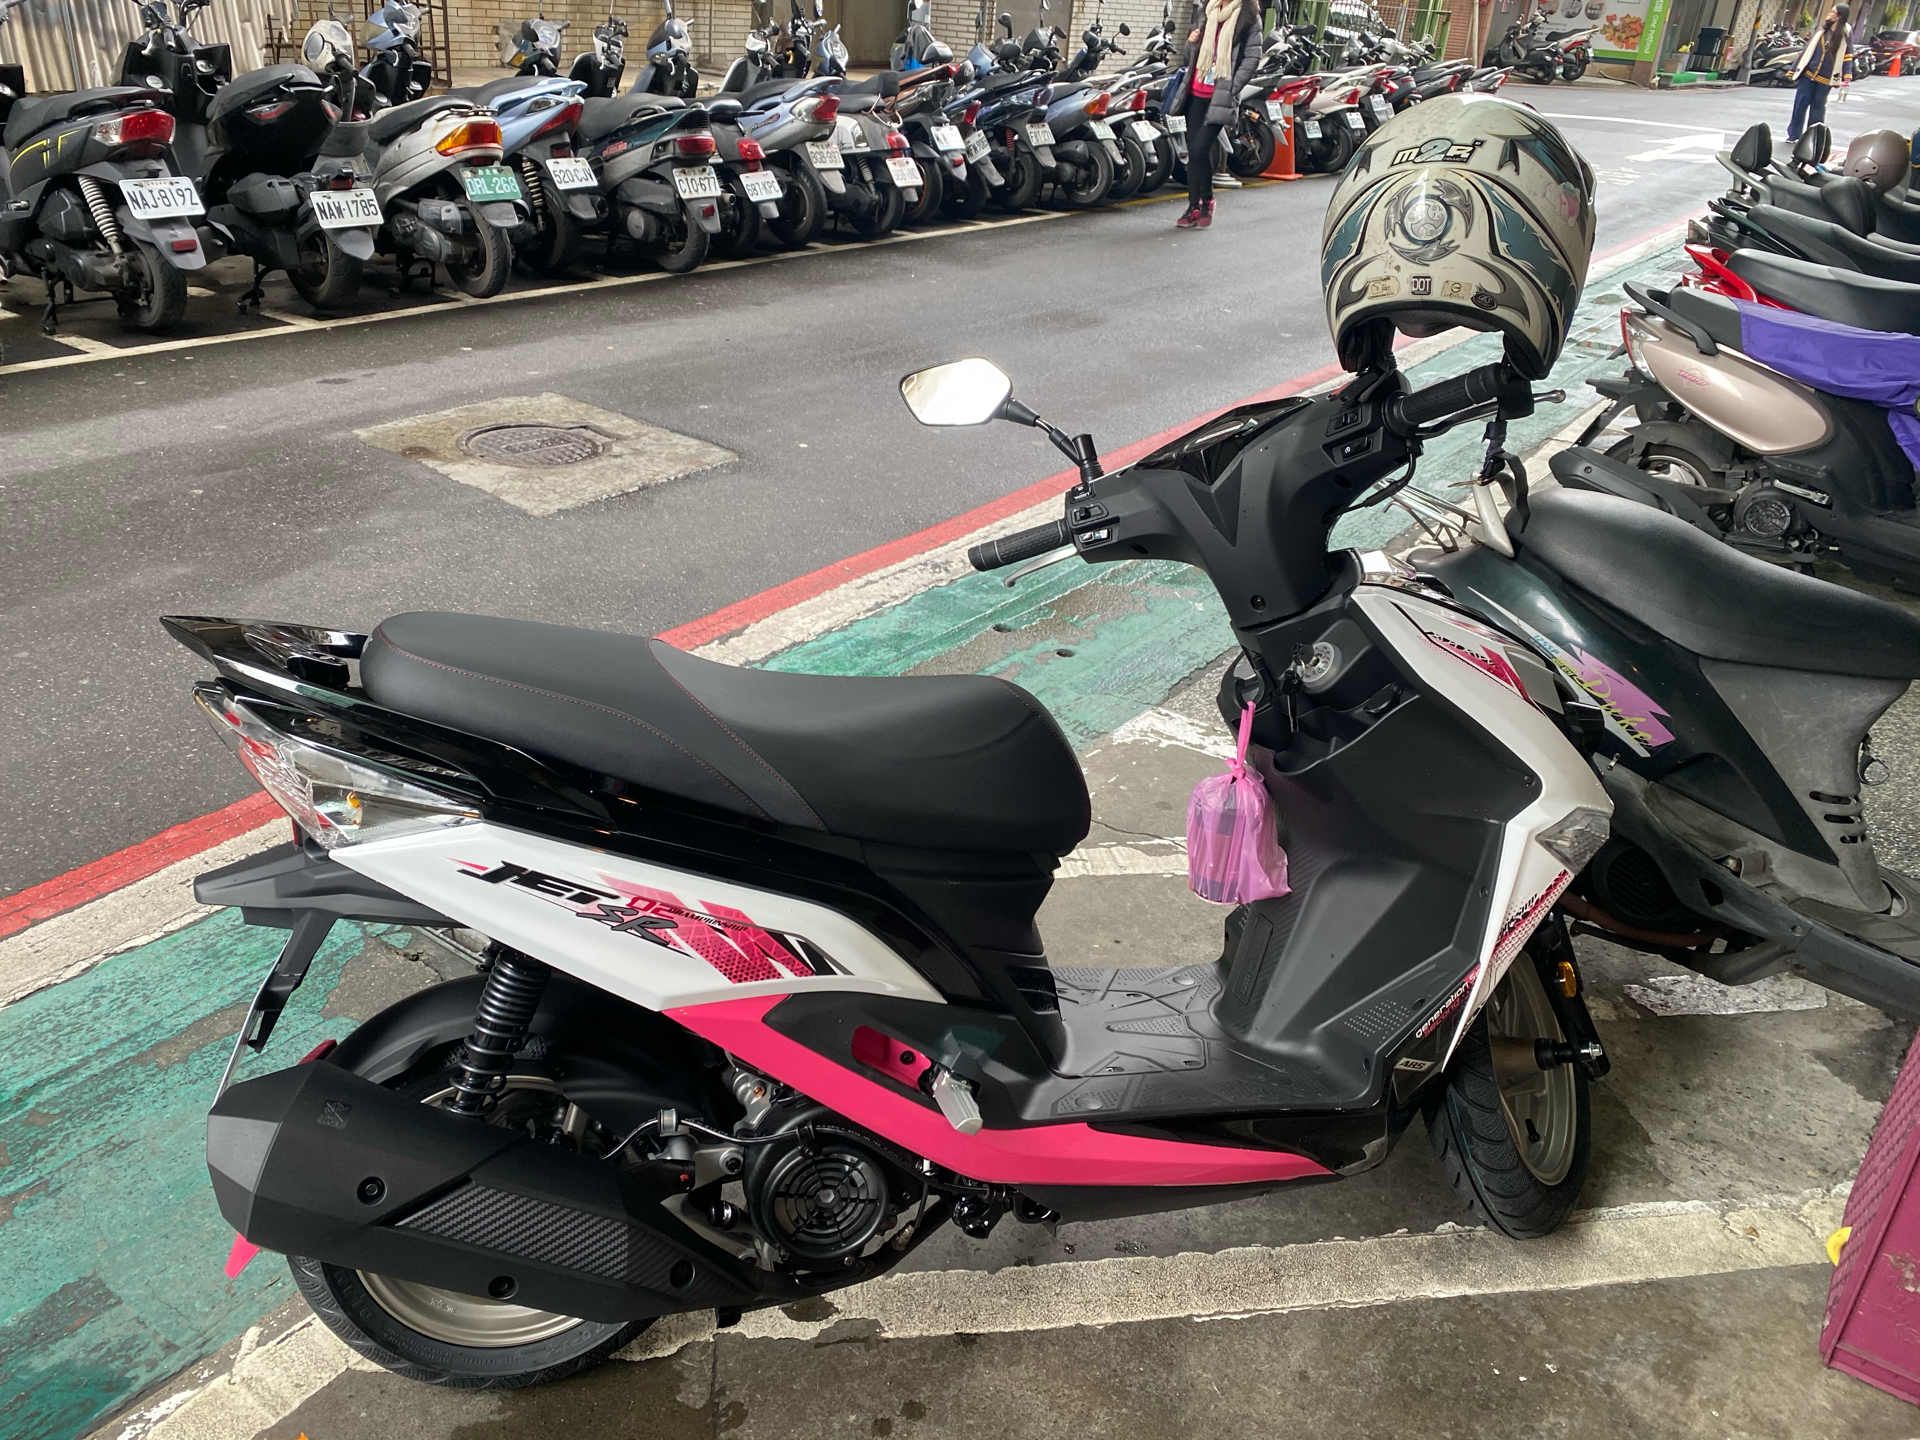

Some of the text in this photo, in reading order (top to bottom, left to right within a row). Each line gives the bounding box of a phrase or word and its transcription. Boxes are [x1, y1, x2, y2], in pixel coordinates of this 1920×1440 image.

[126, 187, 199, 210] NAJ-8192
[1412, 278, 1431, 293] DOT
[457, 860, 620, 904] JET
[576, 904, 678, 946] SR
[1415, 982, 1469, 1038] generation
